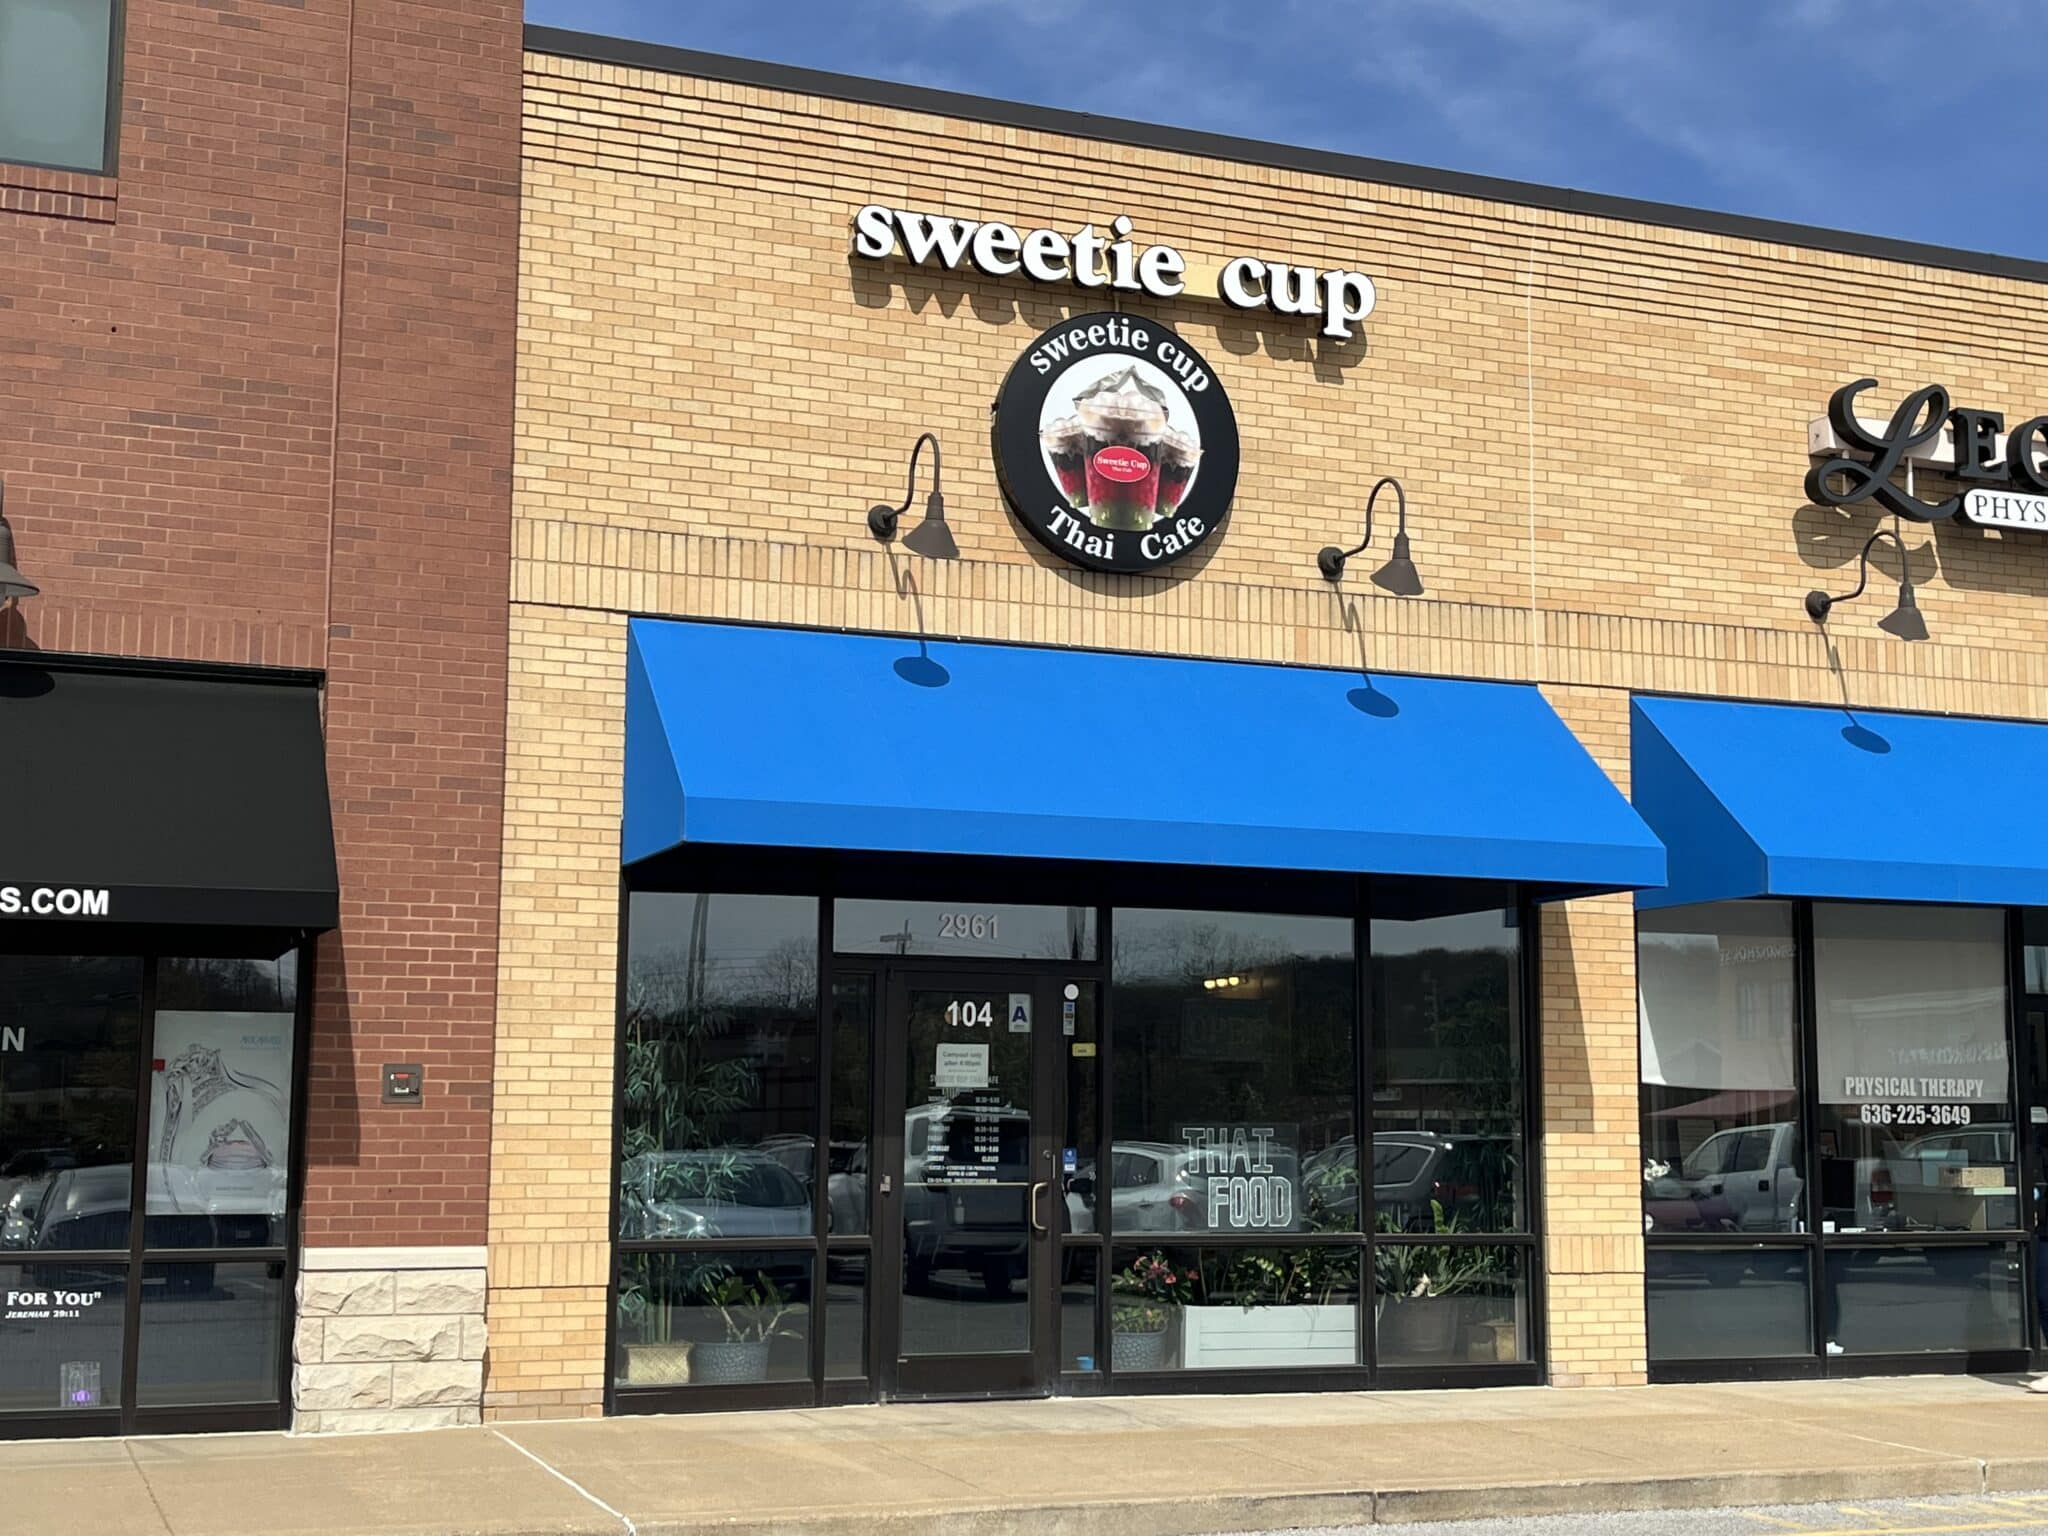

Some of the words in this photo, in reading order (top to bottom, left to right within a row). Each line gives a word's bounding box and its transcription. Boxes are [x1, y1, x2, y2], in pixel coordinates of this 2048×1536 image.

[854, 204, 1186, 298] sweetie
[1219, 256, 1377, 338] cup
[1030, 317, 1150, 375] sweetie
[1156, 341, 1210, 393] cup
[1046, 505, 1114, 560] Thai
[1140, 516, 1205, 560] Cafe
[0, 886, 109, 915] S.COM
[938, 913, 999, 939] 2961
[946, 1000, 993, 1027] 104
[1012, 1005, 1028, 1022] A
[1844, 1076, 1917, 1097] PHYSICAL
[1919, 1077, 1984, 1098] THERAPY
[1861, 1104, 1971, 1125] 636-225-3649
[1182, 1127, 1274, 1174] THAI
[1207, 1176, 1292, 1228] FOOD
[6, 1291, 49, 1306] FOR
